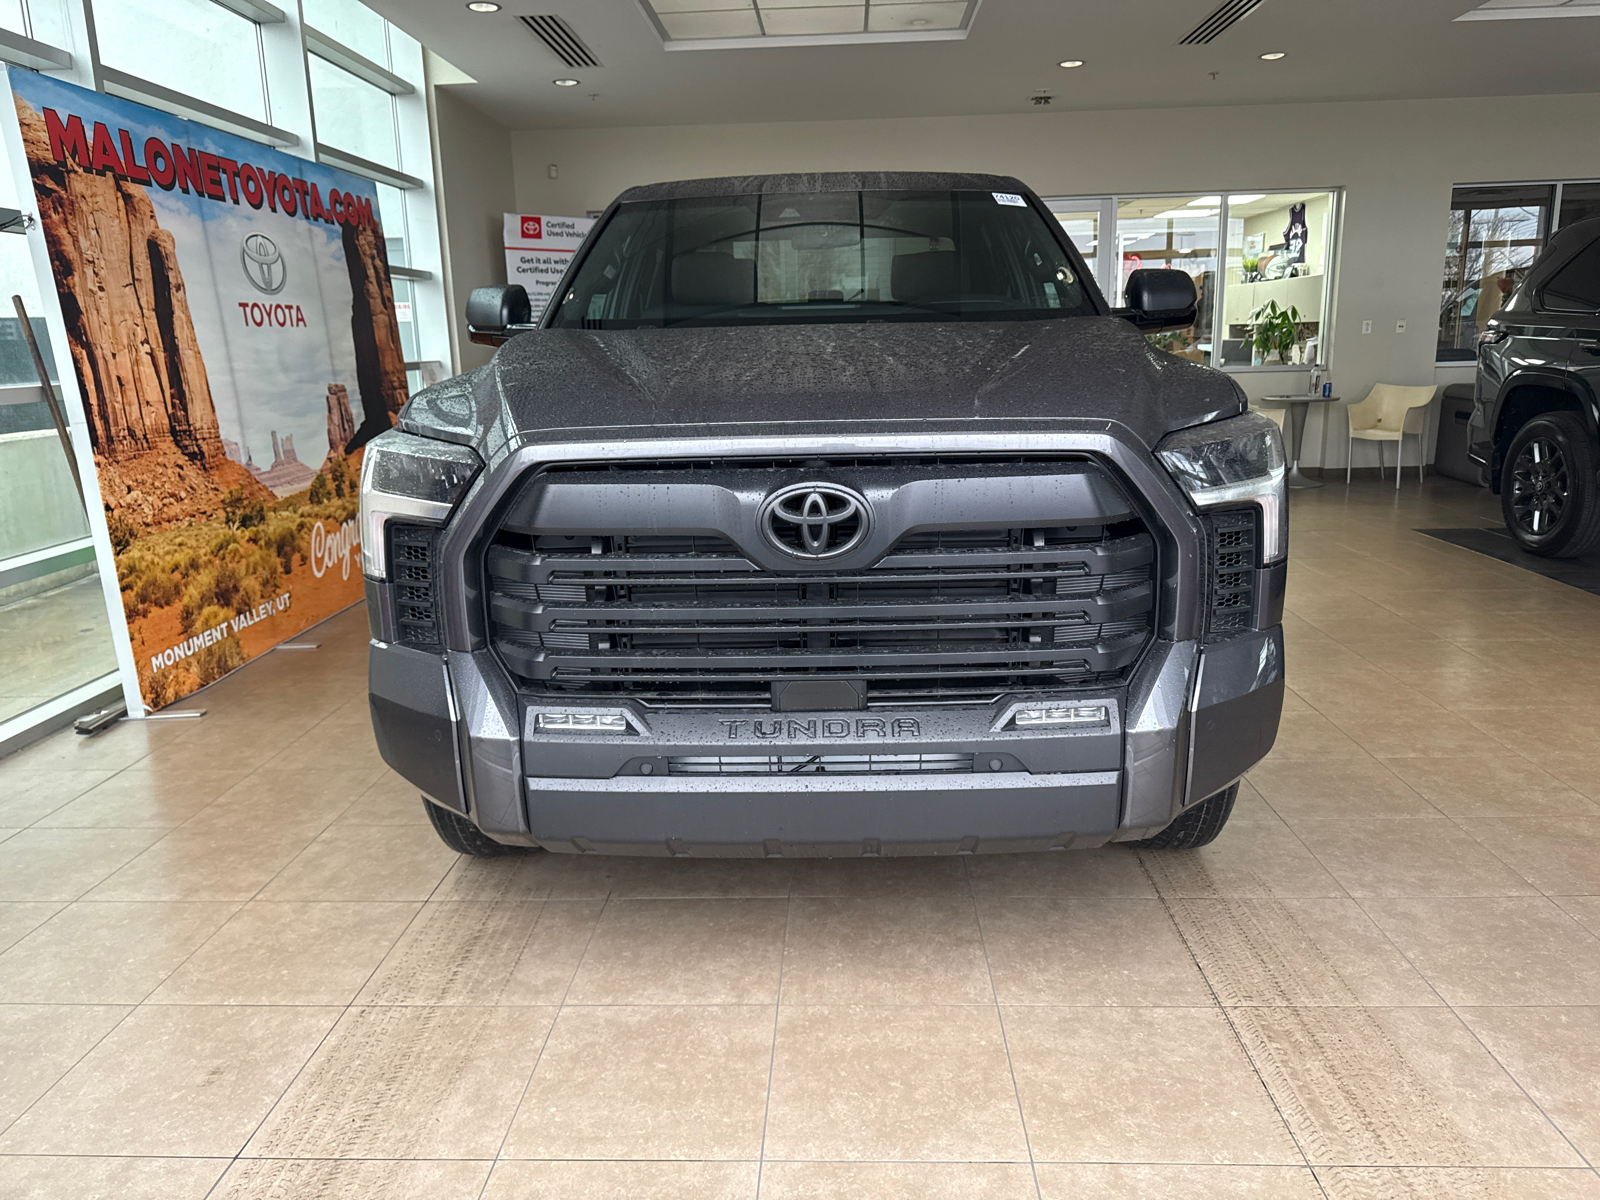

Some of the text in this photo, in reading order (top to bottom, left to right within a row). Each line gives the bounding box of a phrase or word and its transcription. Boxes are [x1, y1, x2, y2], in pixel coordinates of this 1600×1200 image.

[42, 106, 376, 228] MALONETOYOTA.COM
[546, 221, 575, 229] Certified
[516, 266, 549, 274] Certified
[520, 256, 534, 265] Get
[535, 256, 541, 264] it
[542, 257, 552, 265] all
[238, 302, 307, 328] TOYOTA
[151, 592, 291, 673] MONUMENT VALLEY, UT
[718, 718, 921, 739] TUNDRA
